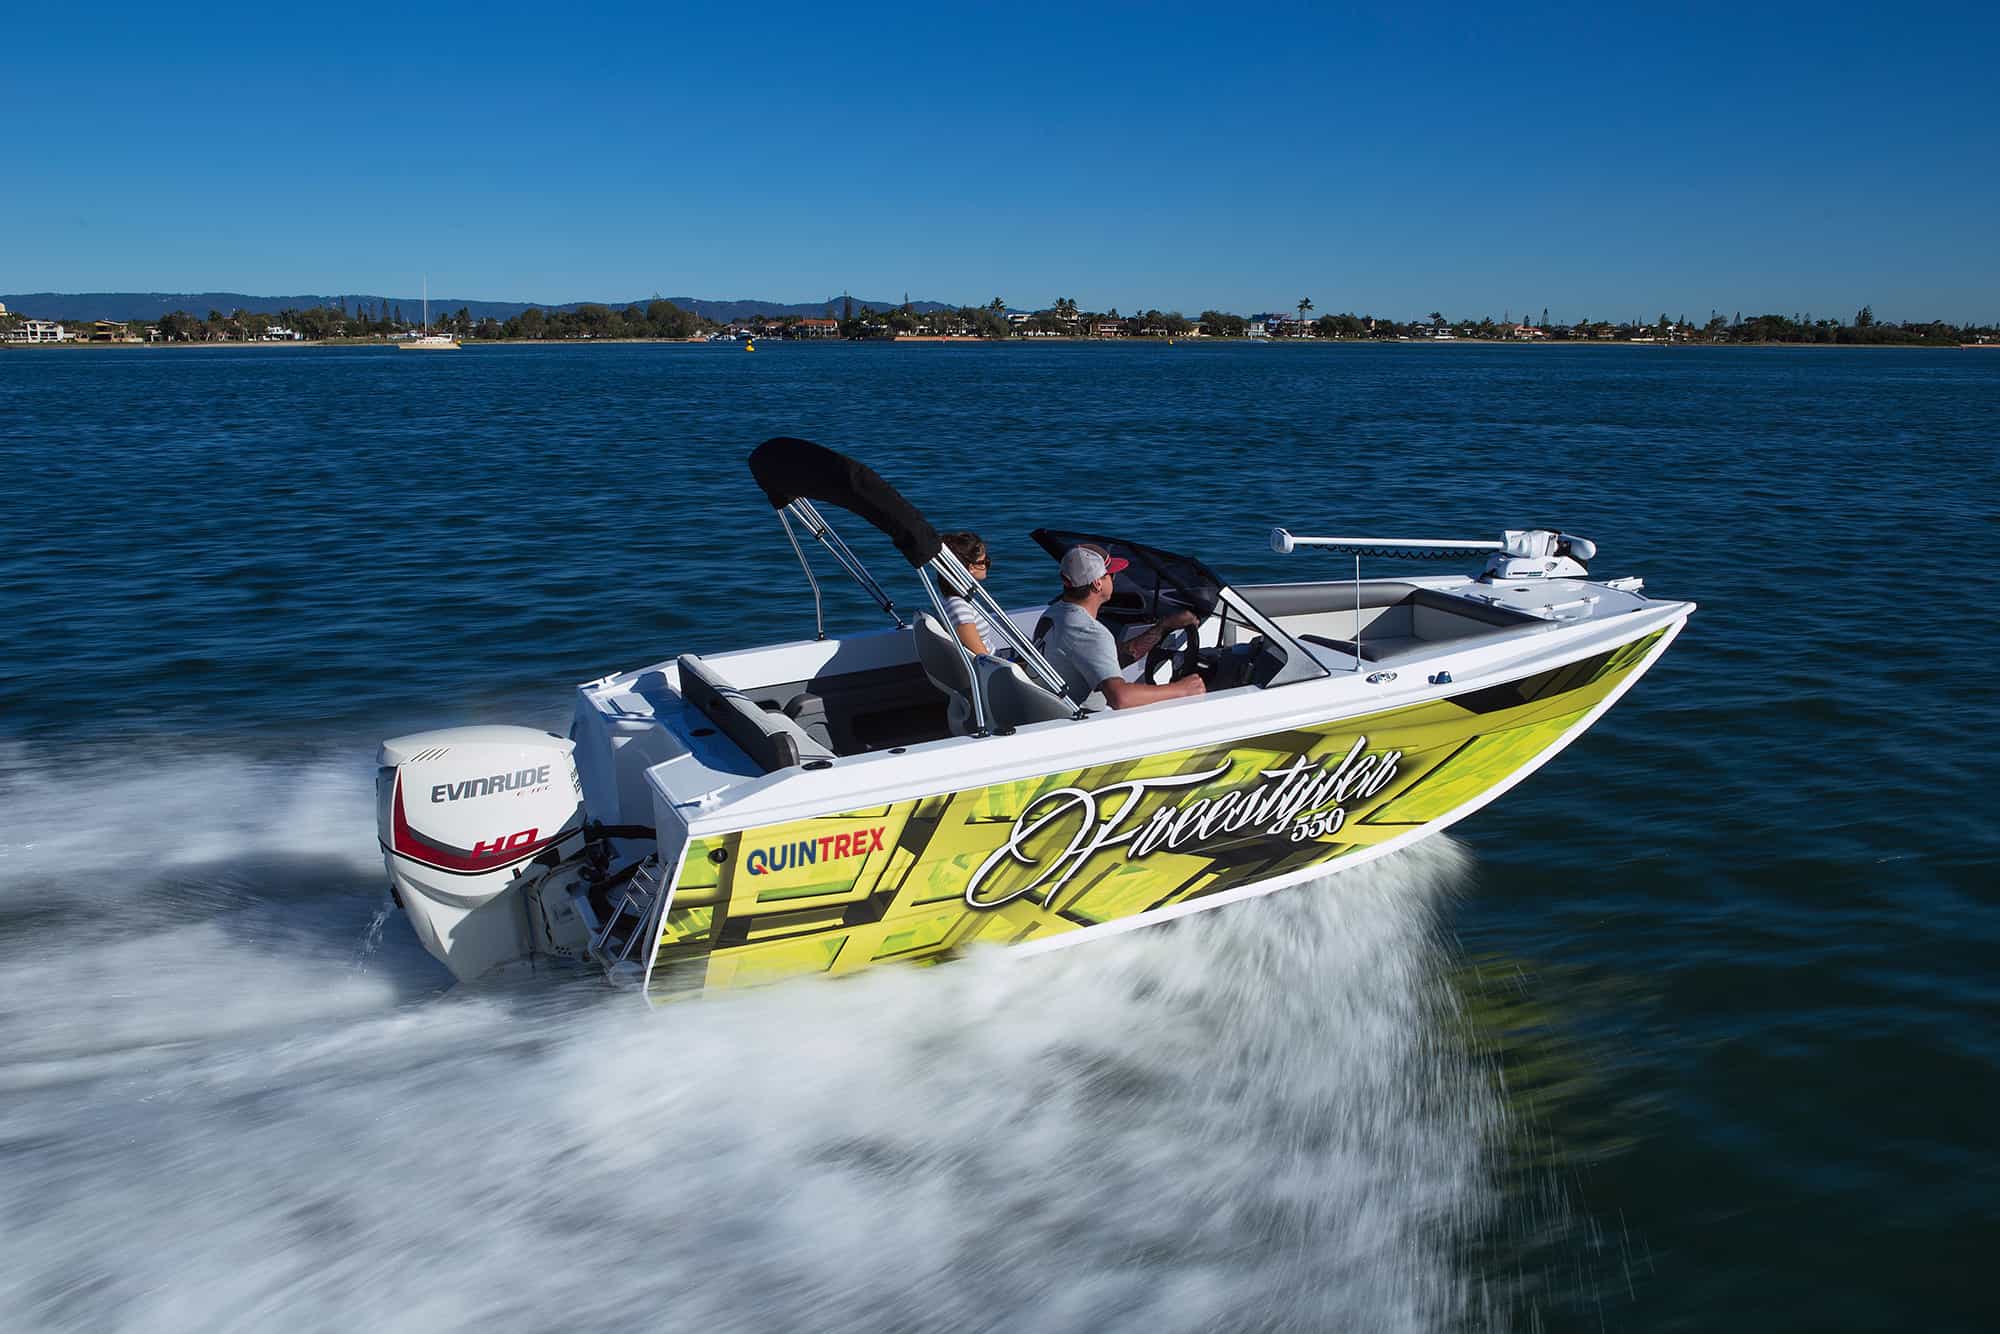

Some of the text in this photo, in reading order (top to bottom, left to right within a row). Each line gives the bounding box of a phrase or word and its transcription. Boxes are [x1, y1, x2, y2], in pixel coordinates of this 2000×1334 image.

[432, 765, 551, 803] EVINRUDE
[966, 736, 1401, 908] Freestyler
[1292, 808, 1344, 842] 550
[471, 828, 539, 859] HO
[747, 827, 885, 875] QUINTREX
